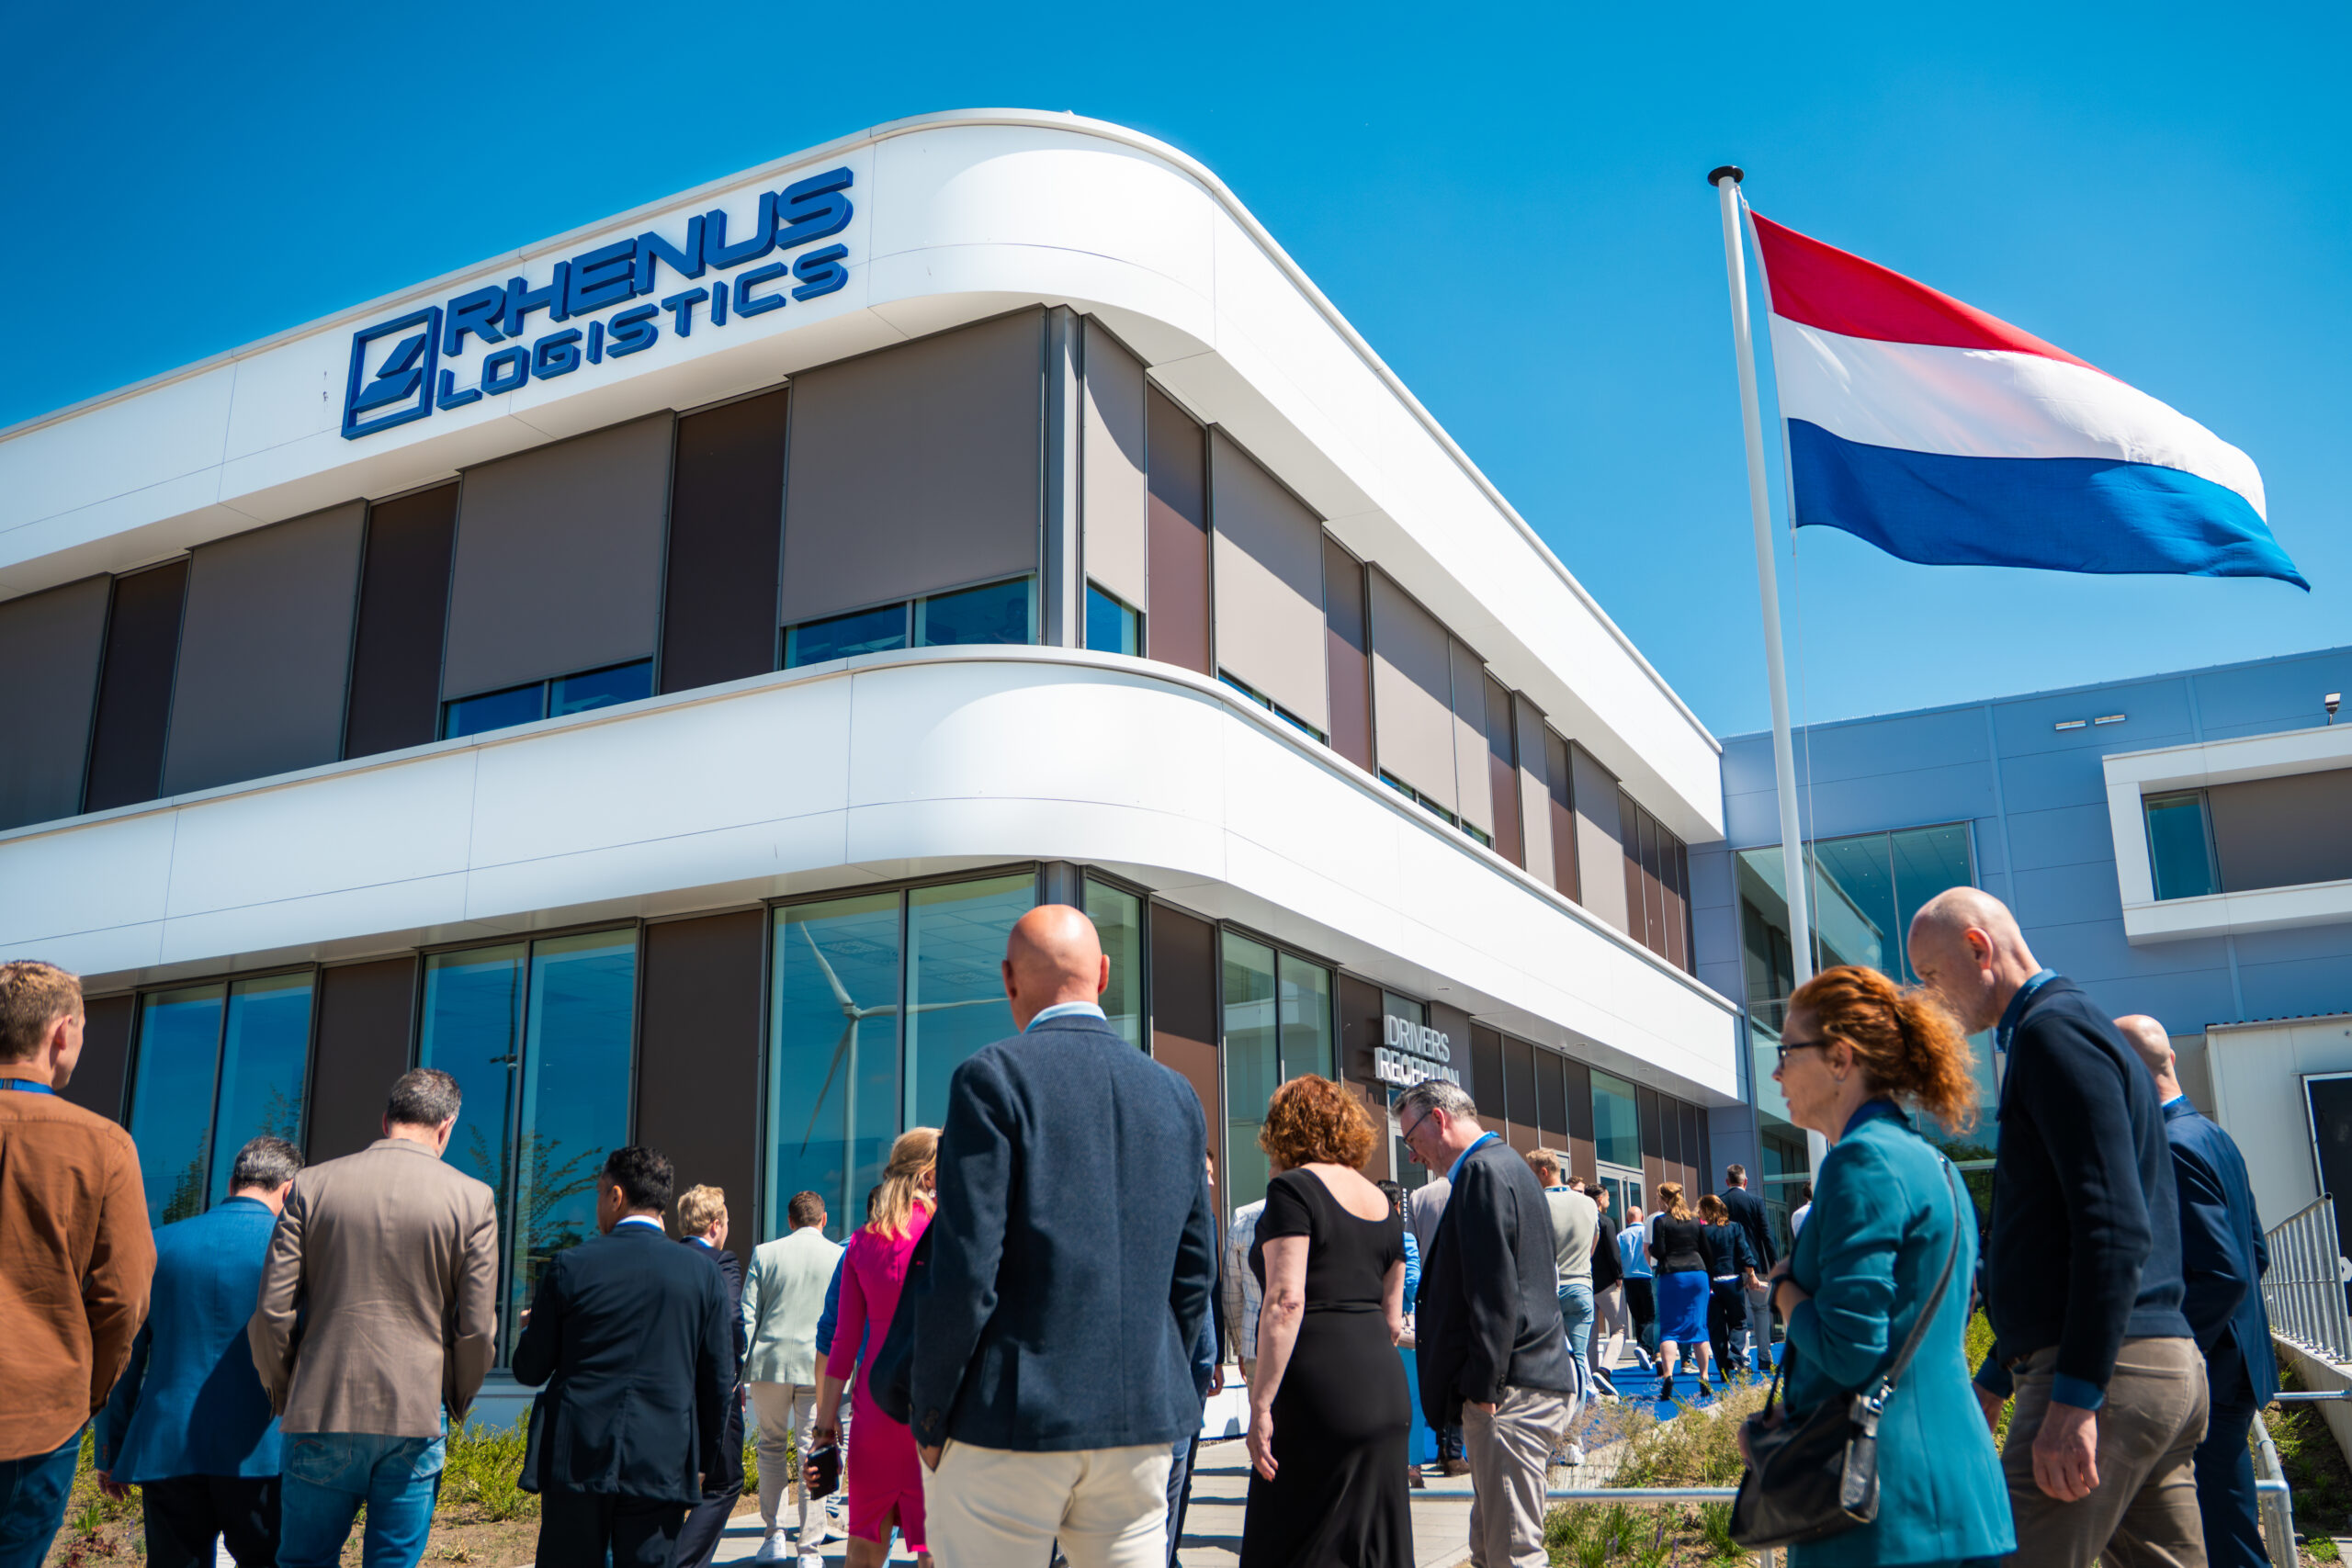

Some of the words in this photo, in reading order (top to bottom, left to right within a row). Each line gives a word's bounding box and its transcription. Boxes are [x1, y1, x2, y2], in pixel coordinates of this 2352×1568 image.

[436, 243, 848, 411] LOGISTICS
[442, 166, 854, 357] RHENUS
[1384, 1014, 1450, 1063] DRIVERS
